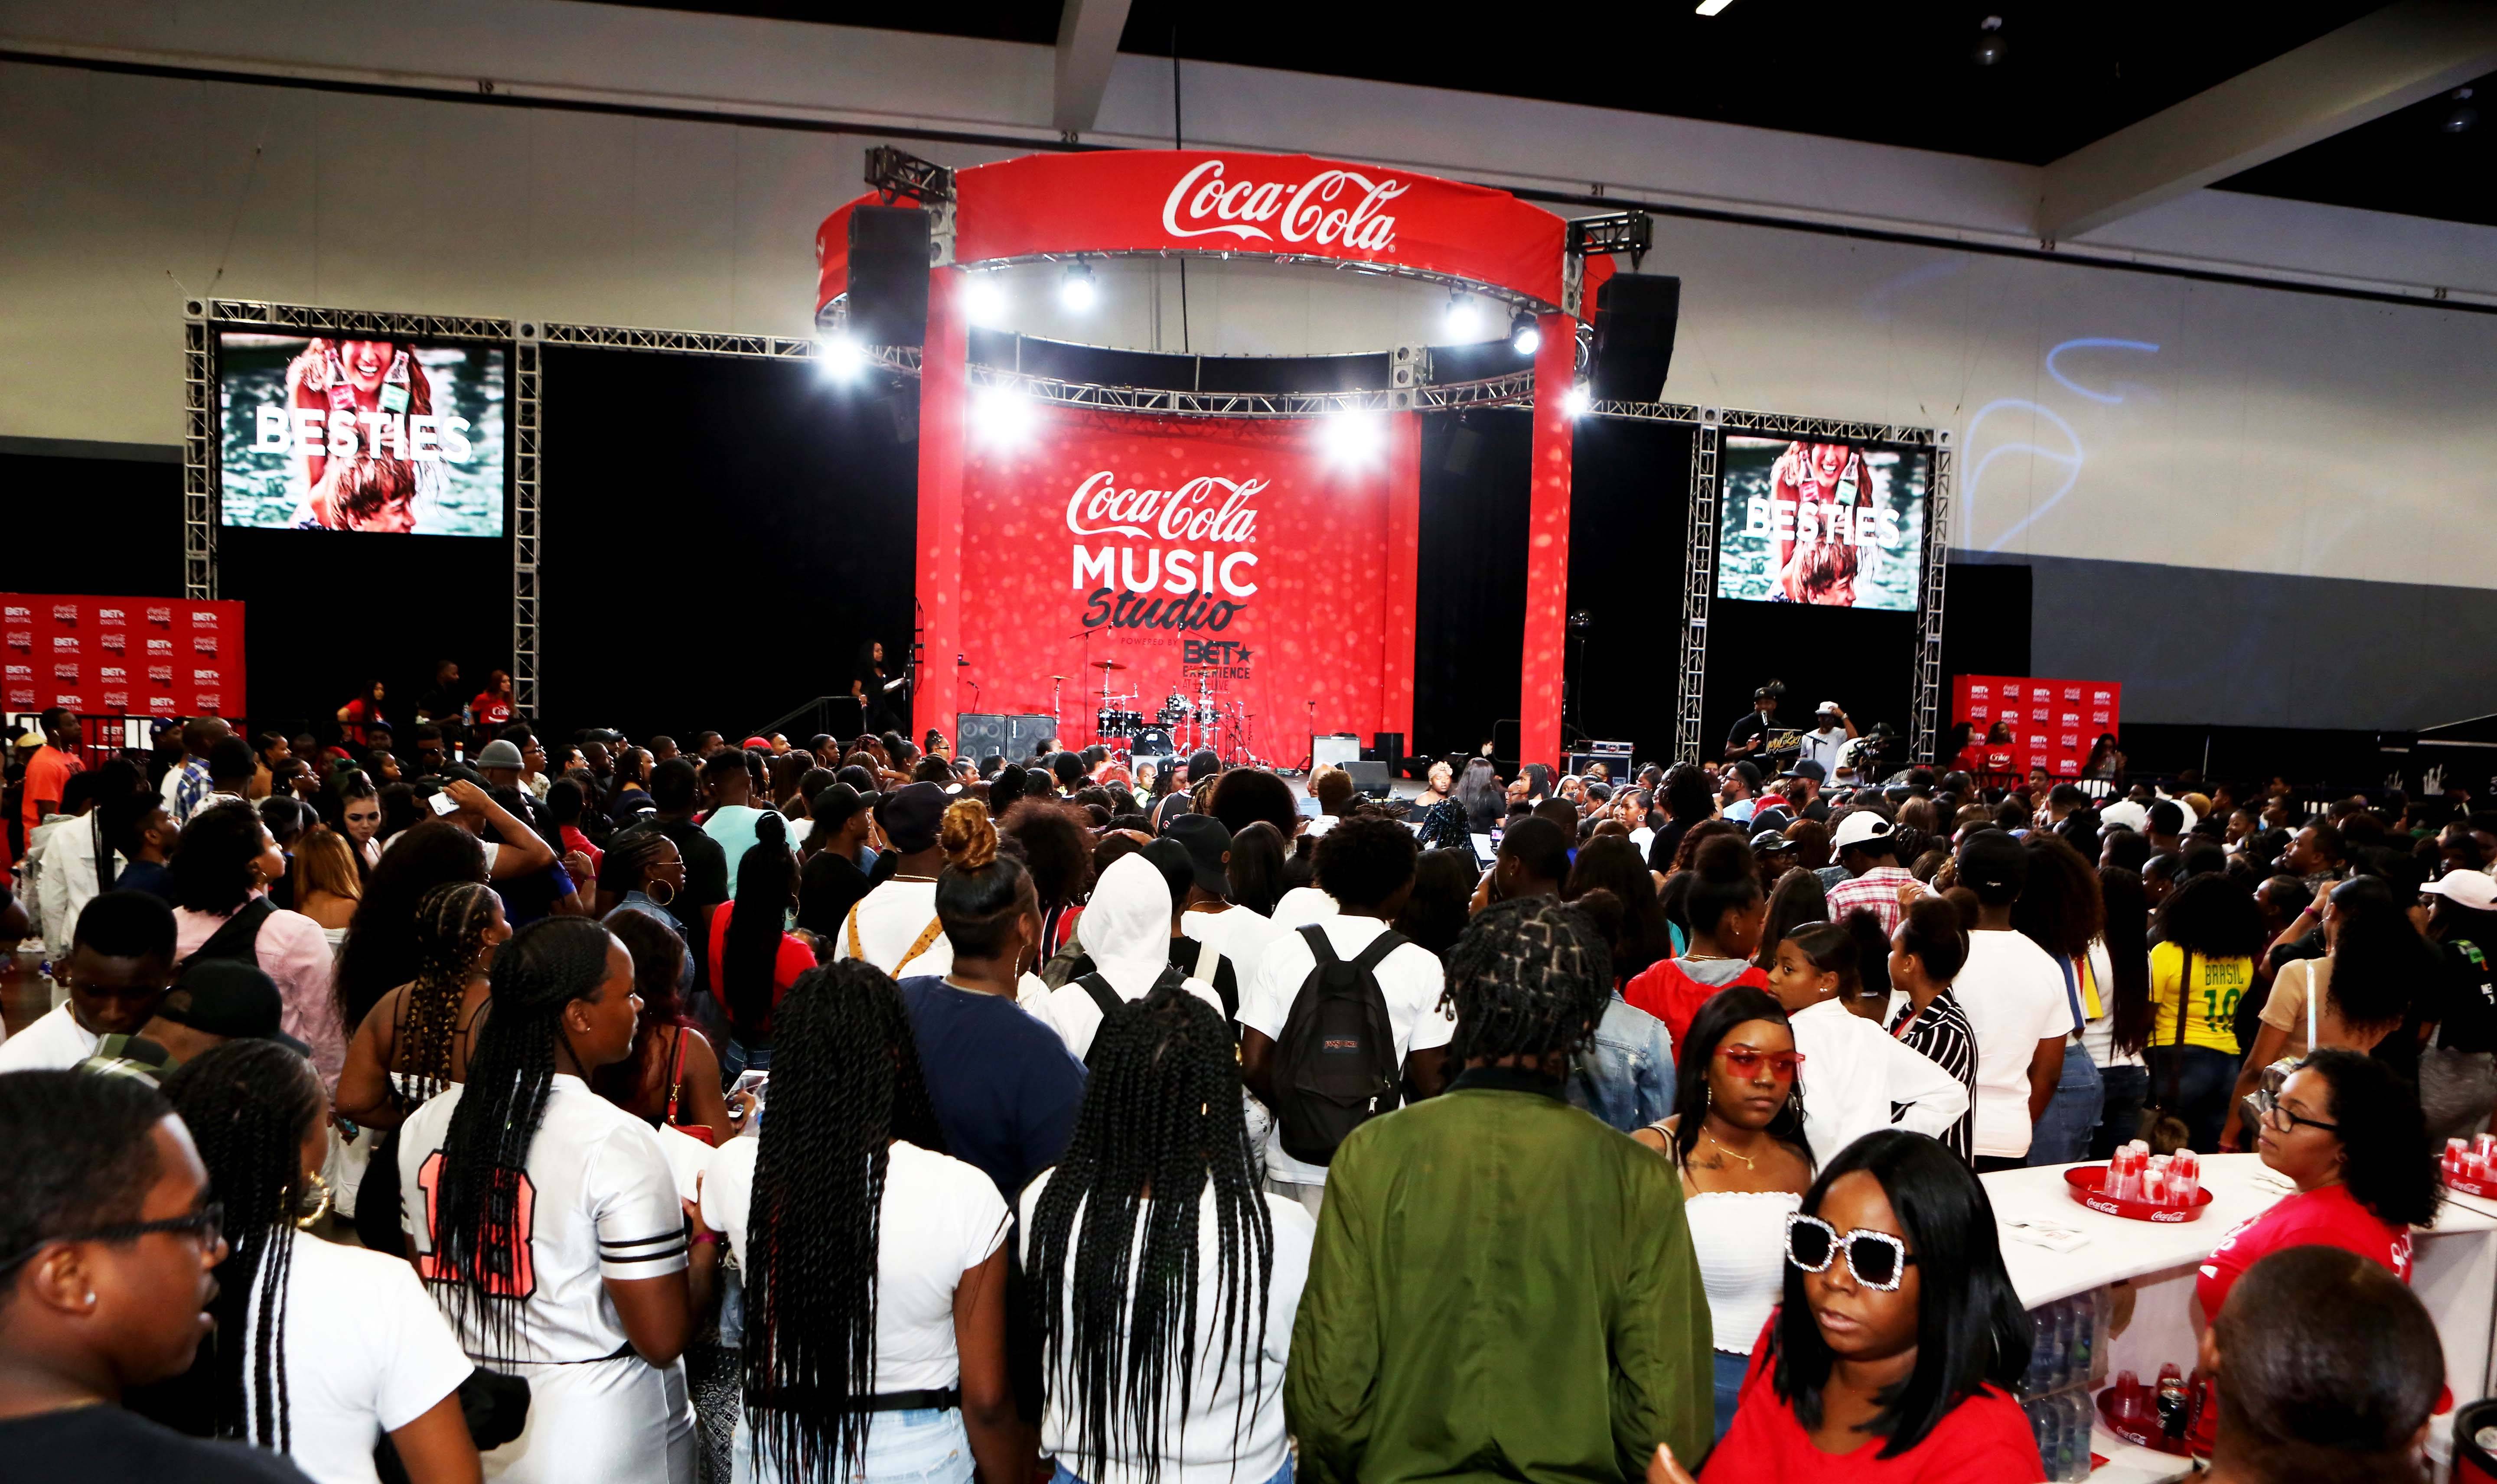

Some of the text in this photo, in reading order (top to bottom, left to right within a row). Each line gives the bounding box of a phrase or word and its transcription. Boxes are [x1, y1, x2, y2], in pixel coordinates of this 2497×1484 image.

[1162, 160, 1411, 250] Coca-Cola
[256, 406, 473, 464] BESTIES
[1066, 471, 1270, 543] Coca-Cola
[1746, 497, 1900, 549] BESTIES
[1072, 545, 1258, 597] MUSIC
[1082, 588, 1247, 632] Studio
[1121, 637, 1164, 646] POWERED
[1183, 640, 1240, 664] BET
[2205, 963, 2244, 986] BRASIL
[2086, 1198, 2119, 1214] Coca-Cola
[2151, 1211, 2186, 1222] Coca-Cola
